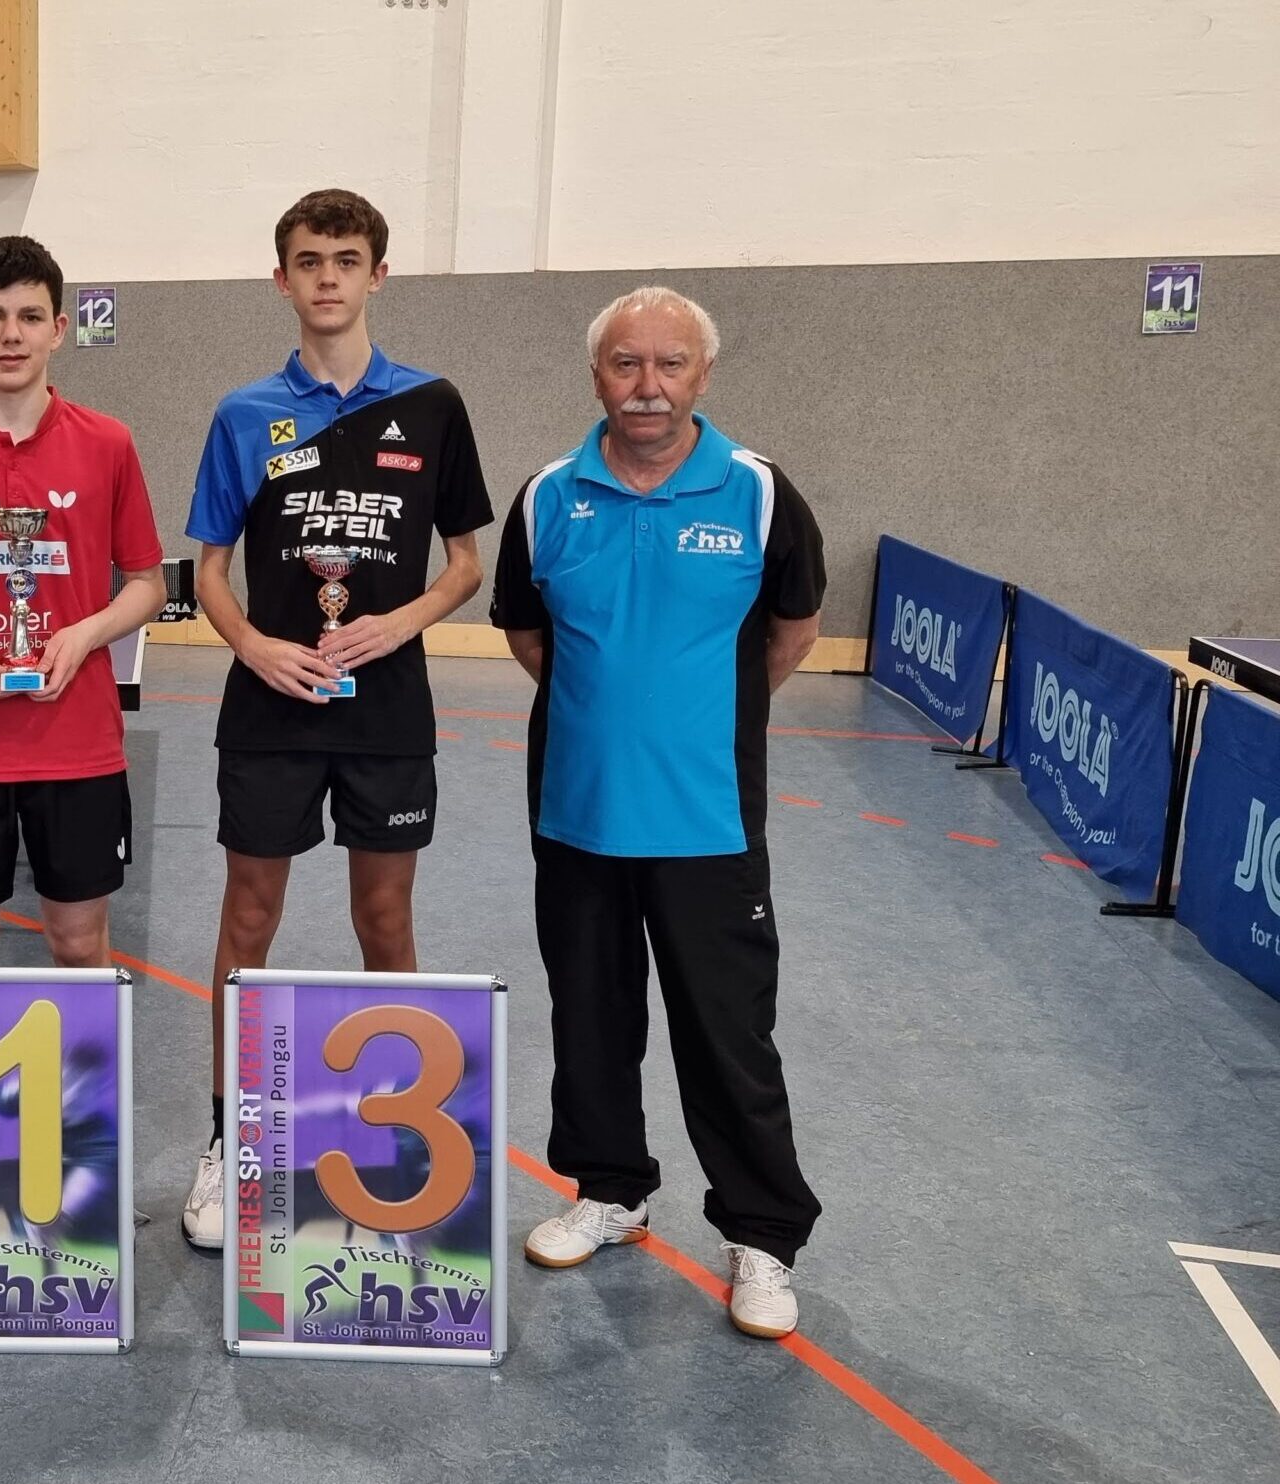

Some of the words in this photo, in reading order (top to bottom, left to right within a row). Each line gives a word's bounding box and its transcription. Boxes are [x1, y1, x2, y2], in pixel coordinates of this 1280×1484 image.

[1152, 275, 1194, 312] 11
[80, 298, 113, 328] 12
[285, 448, 318, 466] SSM
[281, 490, 403, 519] SILBER
[301, 514, 391, 542] PFEIL
[698, 530, 744, 549] hsv
[388, 808, 428, 826] JOOLA
[1084, 827, 1116, 845] you!
[1251, 922, 1272, 948] for
[271, 1025, 290, 1100] Pongau
[269, 1111, 286, 1134] im
[315, 1005, 475, 1234] 3
[269, 1143, 286, 1217] Johann
[270, 1227, 286, 1254] St.
[341, 1246, 482, 1287] Tischtennis
[359, 1272, 486, 1325] hsv
[29, 1317, 48, 1330] im
[54, 1318, 115, 1333] Pongau
[303, 1322, 325, 1336] St.
[331, 1324, 392, 1339] Johann
[397, 1327, 416, 1340] im
[423, 1327, 486, 1344] Pongau
